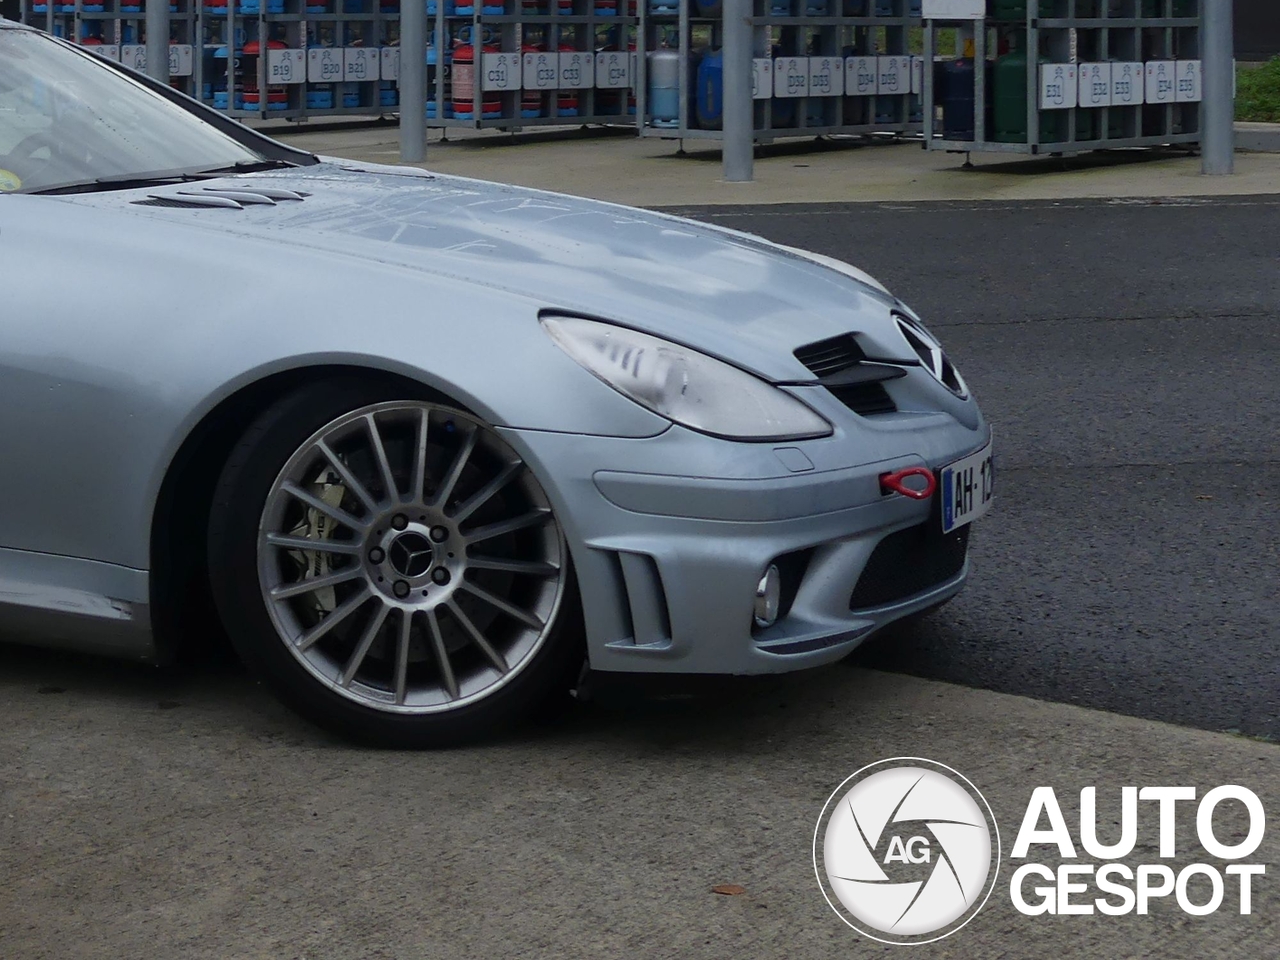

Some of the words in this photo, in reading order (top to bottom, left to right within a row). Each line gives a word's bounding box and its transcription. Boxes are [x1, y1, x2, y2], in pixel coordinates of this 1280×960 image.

[273, 65, 290, 76] B19
[323, 63, 340, 74] B20
[348, 63, 364, 74] B21
[563, 69, 579, 80] C33
[610, 68, 626, 79] C34
[487, 70, 505, 82] C31
[538, 69, 555, 81] C32
[788, 75, 805, 87] D32
[858, 74, 874, 86] D34
[1046, 84, 1061, 98] E31
[1093, 82, 1107, 96] E32
[1115, 81, 1129, 95] E33
[1158, 80, 1172, 93] E34
[1179, 78, 1193, 92] E35
